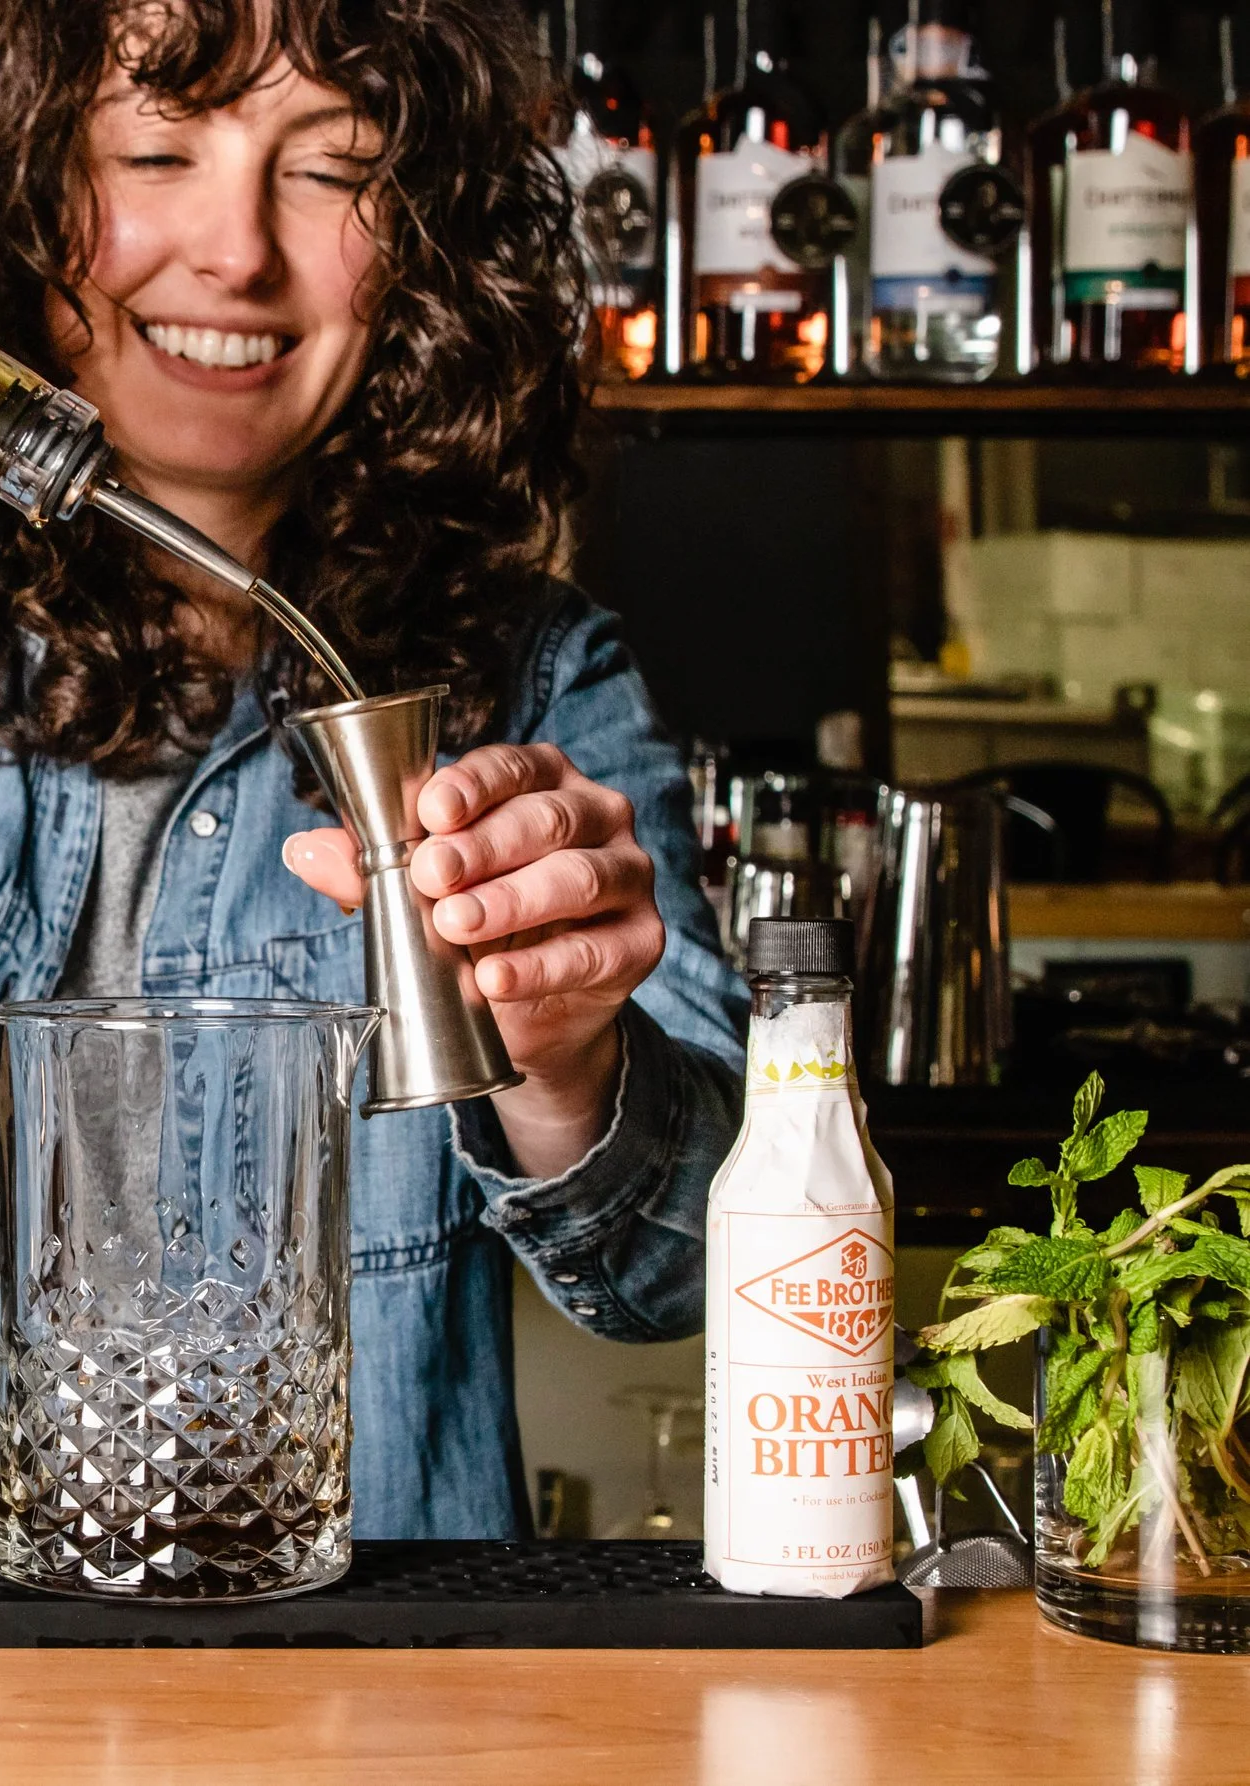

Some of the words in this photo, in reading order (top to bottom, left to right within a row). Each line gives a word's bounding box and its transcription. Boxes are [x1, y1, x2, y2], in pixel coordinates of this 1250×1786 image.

[771, 1278, 811, 1306] FEE
[817, 1276, 894, 1306] BROTHE
[807, 1374, 846, 1389] West
[852, 1370, 887, 1387] Indian
[826, 1496, 843, 1505] use
[846, 1494, 856, 1504] in
[782, 1545, 791, 1559] 5
[797, 1545, 821, 1559] FL
[826, 1544, 851, 1559] OZ
[856, 1541, 879, 1560] (150
